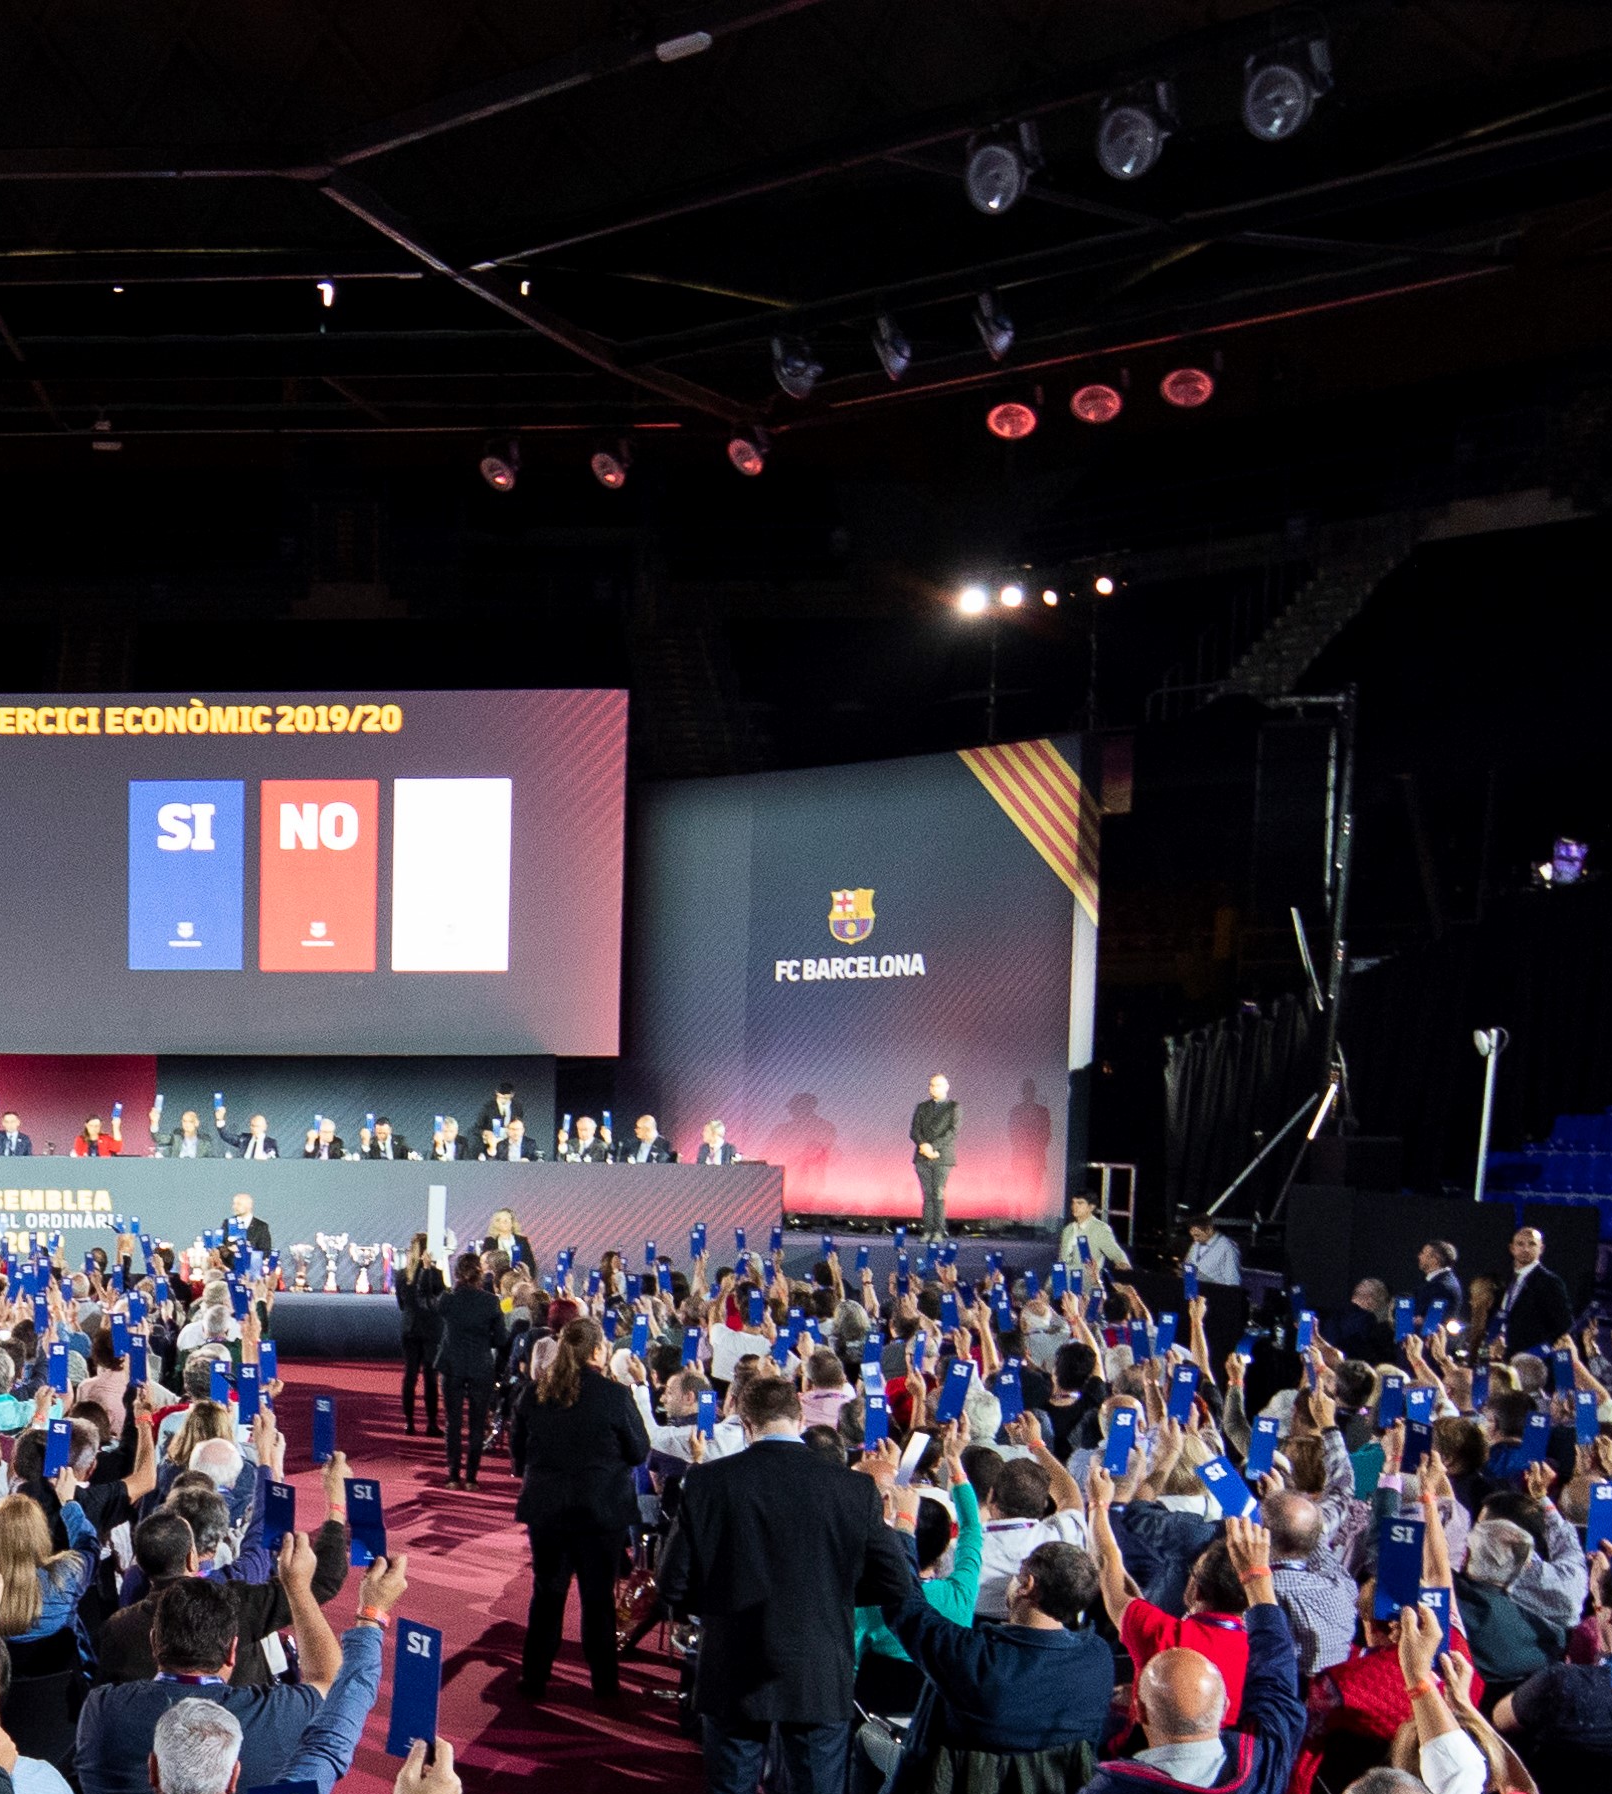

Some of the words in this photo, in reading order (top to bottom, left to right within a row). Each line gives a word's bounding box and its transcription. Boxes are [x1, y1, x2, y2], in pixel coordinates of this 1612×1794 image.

[104, 699, 272, 734] ECONÒMIC
[275, 703, 403, 734] 2019/20
[157, 802, 216, 851] SI
[279, 802, 359, 851] NO
[775, 959, 800, 982] FC
[802, 952, 926, 981] BARCELONA
[25, 1211, 122, 1229] ORDINÀRI
[953, 1364, 969, 1377] SI
[1116, 1413, 1132, 1426] SI
[1258, 1420, 1274, 1433] SI
[1205, 1463, 1227, 1481] SI
[272, 1486, 288, 1499] SI
[353, 1484, 373, 1500] SI
[1596, 1486, 1612, 1499] SI
[1391, 1525, 1414, 1543] SI
[1421, 1593, 1442, 1608] SI
[407, 1631, 431, 1658] SI
